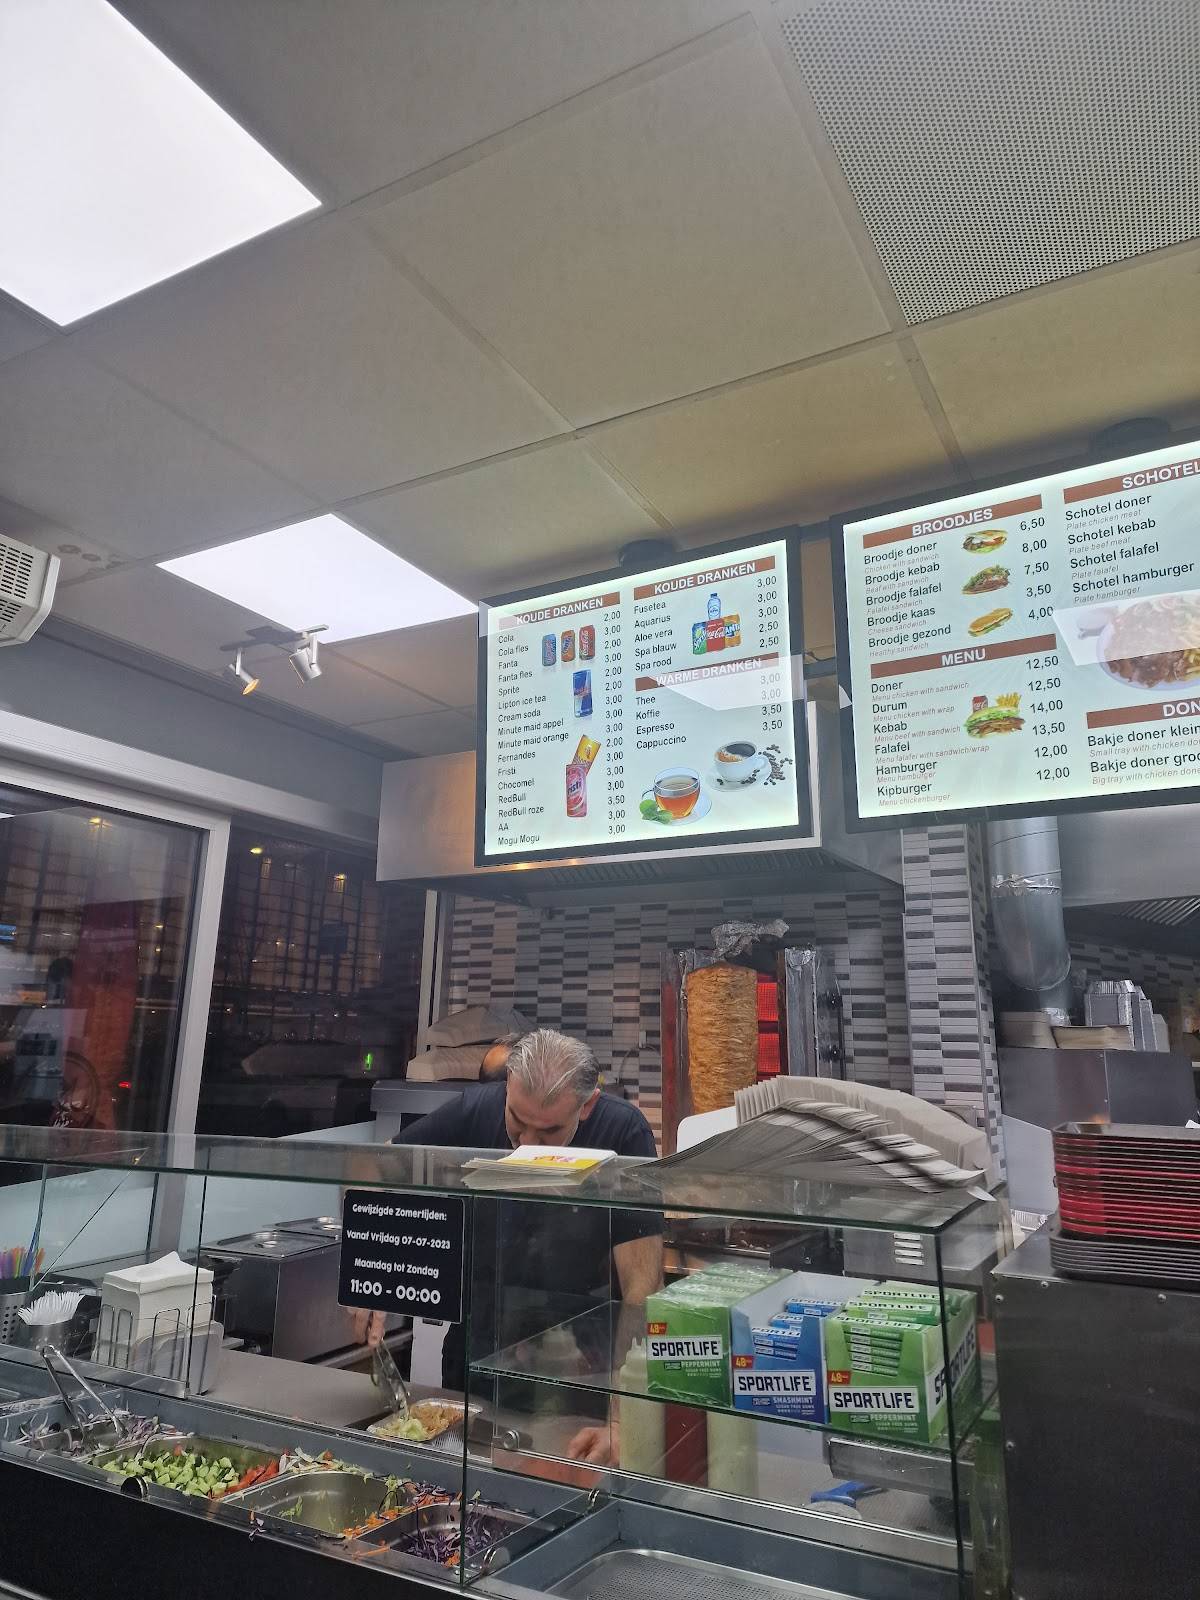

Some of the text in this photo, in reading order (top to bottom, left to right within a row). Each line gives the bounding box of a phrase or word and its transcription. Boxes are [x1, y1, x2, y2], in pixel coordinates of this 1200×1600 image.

[1065, 494, 1152, 521] Schotel doner
[912, 508, 992, 536] BROODJES
[1019, 516, 1045, 531] 6,50
[1067, 517, 1156, 545] Schotel kebab
[1021, 538, 1047, 553] 8,00
[863, 541, 937, 565] Broodje doner
[1069, 541, 1159, 569] Schotel falafel
[864, 561, 940, 585] Broodje kebab
[1023, 560, 1049, 575] 7,50
[654, 562, 755, 594] KOUDE DRANKEN
[756, 575, 777, 588] 3,00
[1072, 562, 1194, 593] Schotel hamburger
[757, 590, 777, 603] 3,00
[865, 582, 942, 606] Broodje falafel
[1026, 583, 1051, 598] 3,50
[516, 597, 603, 625] KOUDE DRANKEN
[633, 601, 666, 614] Fusetea
[757, 605, 778, 618] 3,00
[1027, 605, 1054, 621] 4,00
[603, 609, 621, 622] 2,00
[633, 614, 671, 629] Aquarius
[867, 607, 936, 627] Broodje kaas
[604, 624, 621, 636] 3,00
[758, 620, 779, 633] 2,50
[497, 634, 514, 644] Cola
[634, 628, 673, 643] Aloe vera
[759, 635, 779, 648] 2,50
[868, 623, 951, 648] Broodje gezond
[497, 644, 529, 657] Cola fles
[604, 637, 622, 650] 2,00
[634, 642, 677, 658] Spa blauw
[604, 651, 622, 663] 3,00
[634, 655, 672, 672] Spa rood
[942, 648, 985, 665] MENU
[1025, 654, 1059, 670] 12,50
[498, 660, 518, 669] Fanta
[604, 665, 622, 677] 2,00
[498, 670, 533, 682] Fanta fles
[655, 658, 762, 686] WARME DRANKEN
[759, 672, 781, 685] 3,00
[604, 679, 622, 691] 2,00
[870, 681, 903, 694] Doner
[1027, 676, 1061, 691] 12,50
[497, 685, 520, 697] Sprite
[760, 687, 781, 701] 3,00
[497, 694, 546, 710] Lipton ice tea
[605, 693, 623, 705] 3,00
[635, 695, 656, 705] Thee
[605, 707, 623, 719] 3,00
[761, 703, 782, 716] 3,50
[871, 701, 907, 714] Durum
[1029, 699, 1063, 714] 14,00
[497, 708, 541, 723] Cream soda
[635, 709, 660, 720] Koffie
[497, 717, 564, 736] Minute maid appel
[605, 721, 623, 733] 3,00
[636, 722, 675, 735] Espresso
[762, 719, 783, 731] 3,50
[873, 720, 908, 734] Kebab
[1032, 721, 1065, 736] 13,50
[497, 732, 569, 749] Minute maid orange
[605, 736, 623, 748] 2,00
[636, 735, 687, 750] Cappuccino
[1087, 733, 1124, 747] Bakje
[1127, 729, 1166, 742] doner
[874, 740, 910, 755] Falafel
[1033, 743, 1068, 758] 12,00
[497, 750, 536, 763] Fernandes
[606, 750, 624, 762] 3,00
[497, 766, 516, 776] Fristi
[606, 764, 624, 776] 3,00
[875, 760, 937, 776] Hamburger
[1090, 759, 1127, 773] Bakje
[1129, 755, 1170, 768] doner
[1036, 766, 1070, 780] 12,00
[497, 777, 535, 790] Chocomel
[607, 779, 624, 791] 3,00
[876, 783, 932, 797] Kipburger
[498, 792, 526, 804] RedBull
[607, 794, 625, 805] 3,50
[498, 805, 544, 818] RedBull roze
[607, 808, 626, 821] 3,00
[498, 822, 509, 831] AA
[607, 823, 626, 835] 3,00
[497, 833, 540, 847] Mogu Mogu
[352, 1204, 447, 1221] Gewijzigde Zomertijden:
[347, 1230, 451, 1249] Vanaf Vrijdag 07-07-2023
[354, 1258, 439, 1278] Maandag tot Zondag
[351, 1279, 382, 1296] 11:00
[396, 1285, 441, 1304] 00:00
[650, 1324, 659, 1333] 48
[651, 1341, 719, 1356] SPORTLIFE
[736, 1357, 747, 1367] 48
[738, 1376, 812, 1391] SPORTLIFE
[831, 1372, 842, 1382] 48
[834, 1392, 914, 1408] SPORTLIFE
